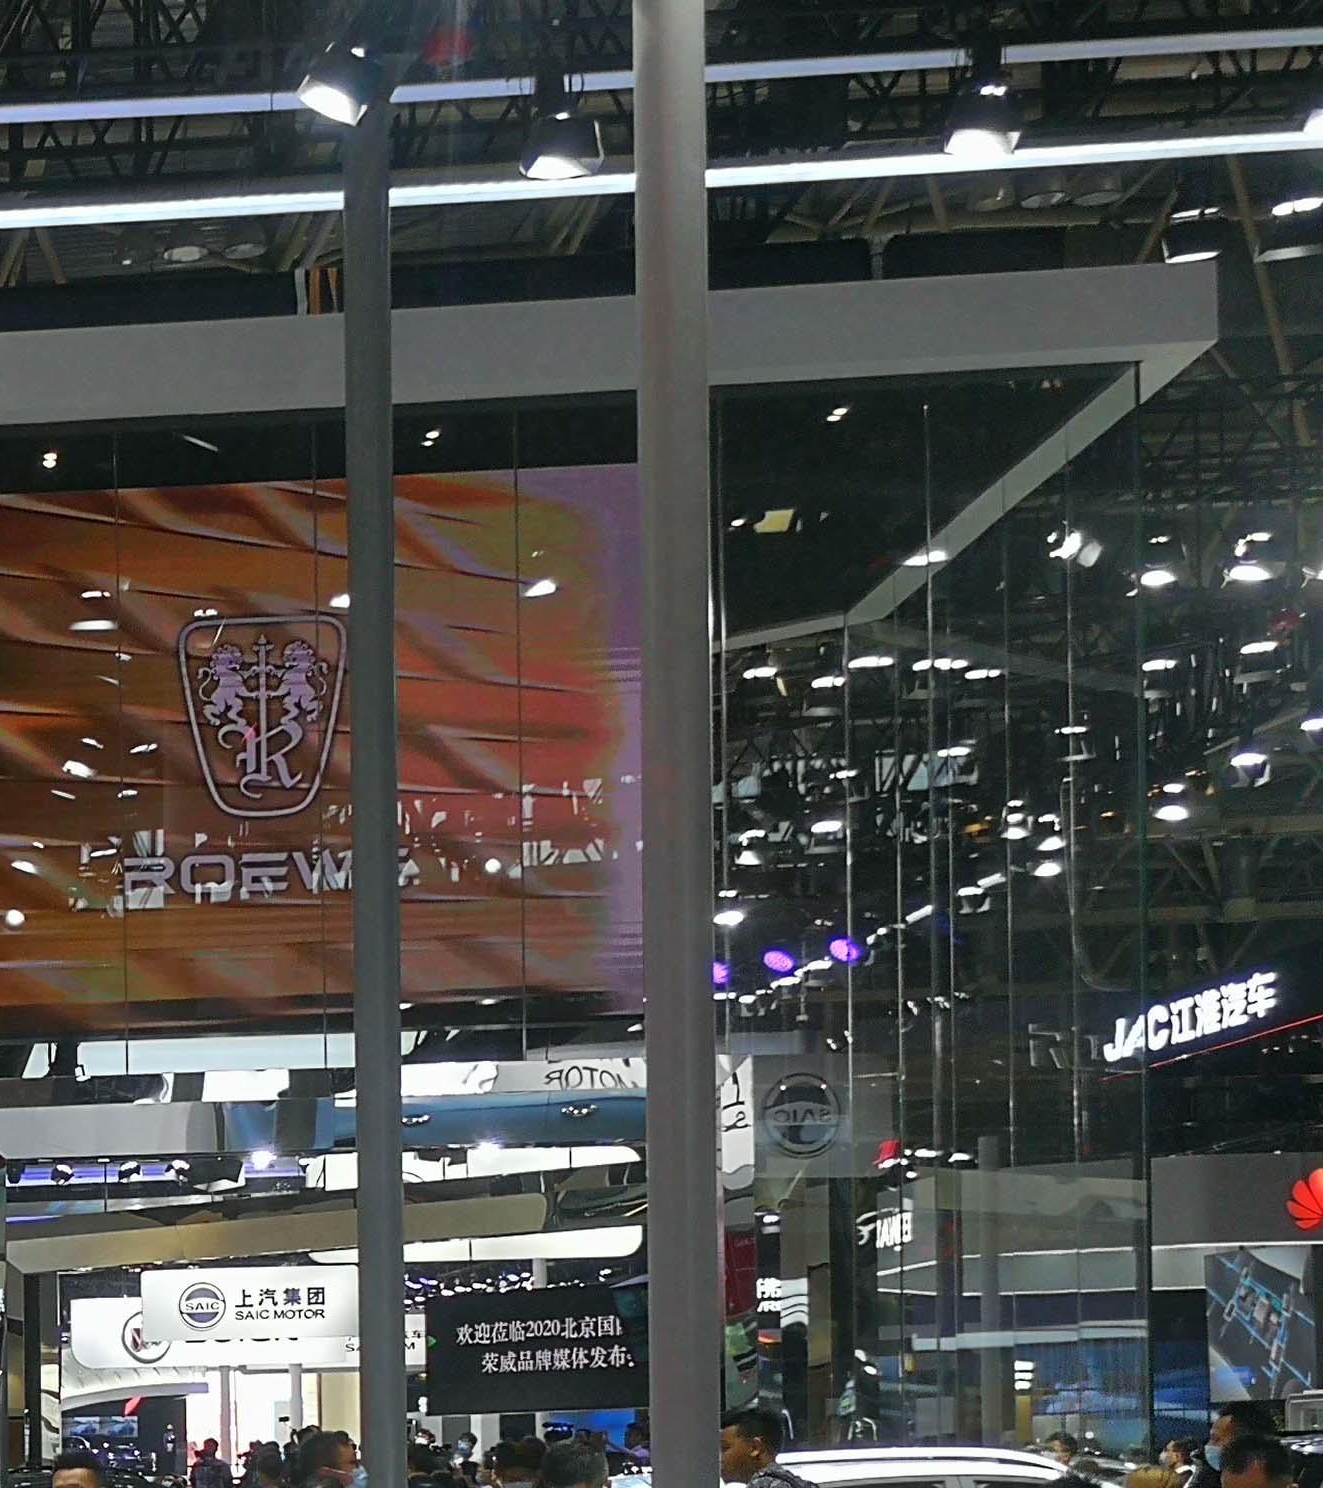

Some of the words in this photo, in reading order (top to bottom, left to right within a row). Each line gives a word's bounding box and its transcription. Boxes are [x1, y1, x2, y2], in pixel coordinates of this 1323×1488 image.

[123, 852, 409, 894] ROEW
[185, 1301, 220, 1311] SAIC
[235, 1287, 325, 1308] 上汽集团
[235, 1310, 270, 1321] SAIC
[273, 1309, 325, 1320] MOTOR
[482, 1344, 635, 1374] 荣威品牌媒体发布
